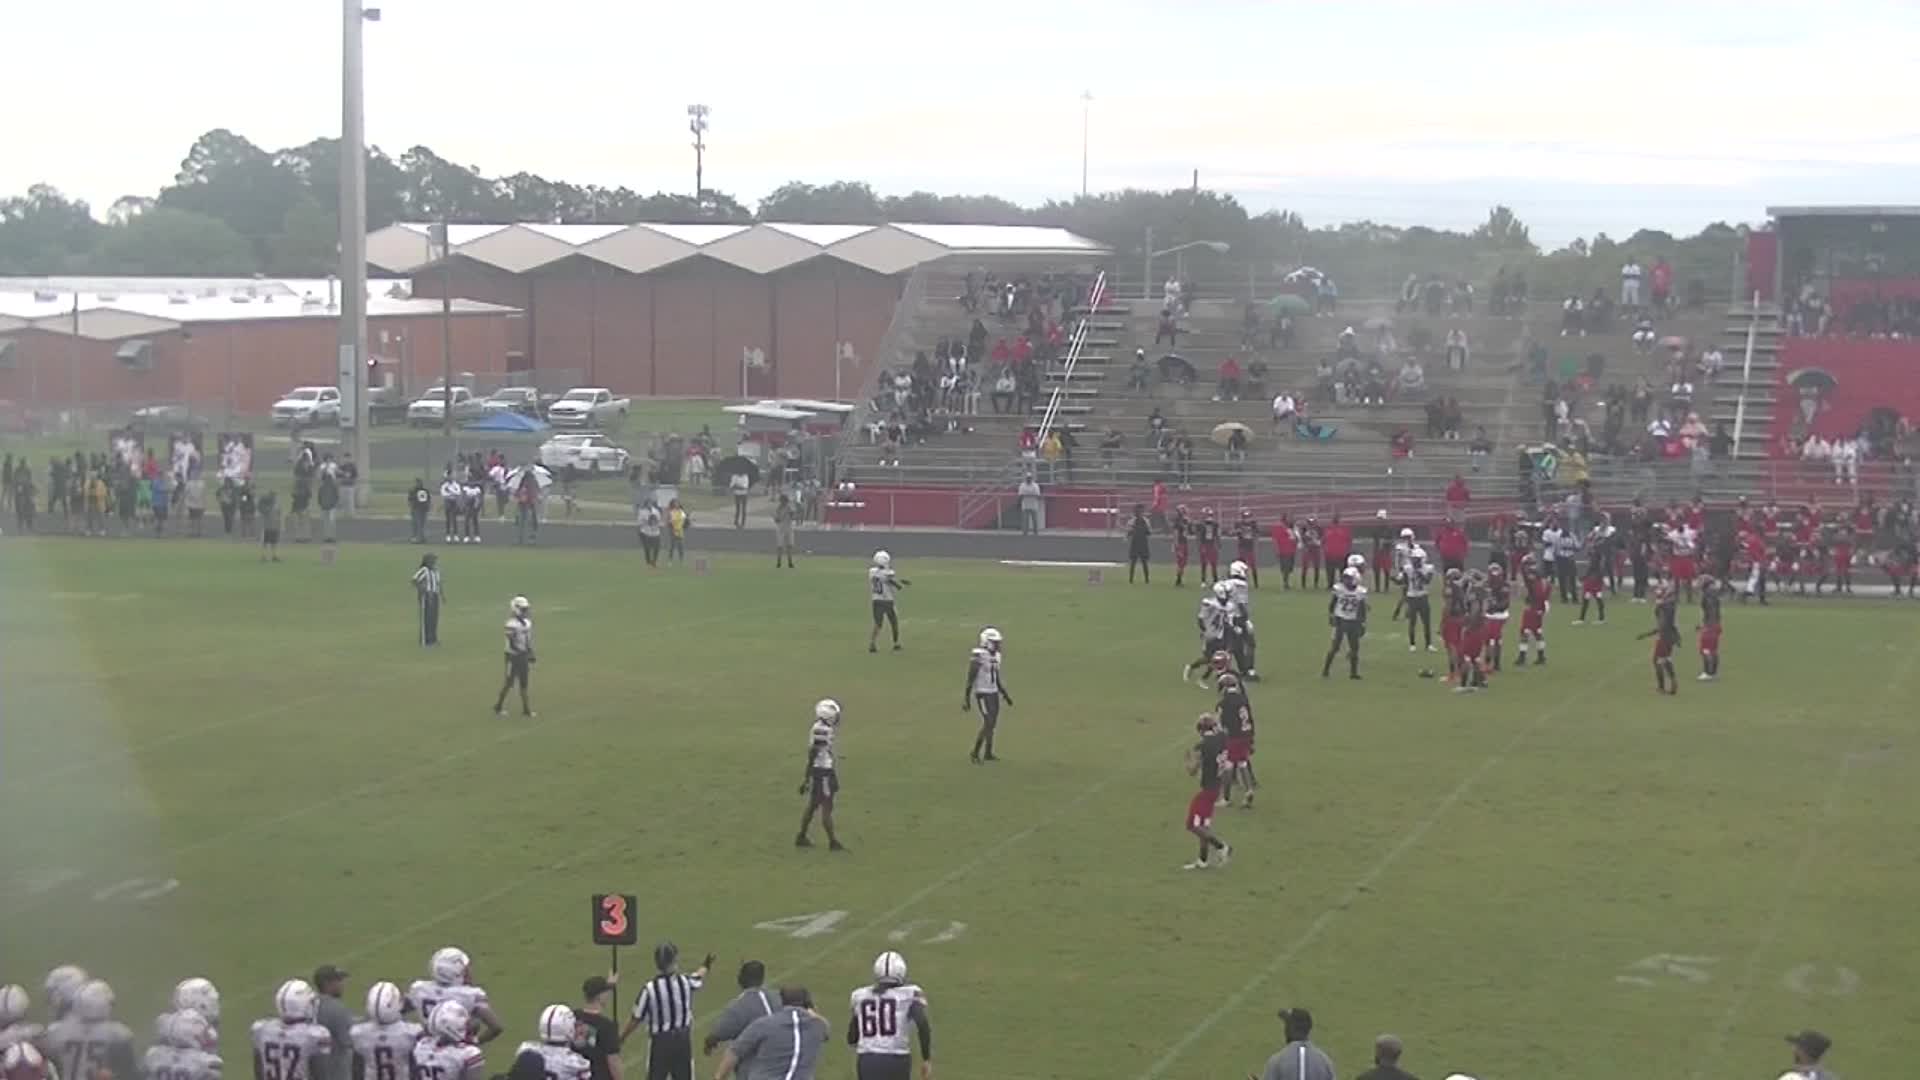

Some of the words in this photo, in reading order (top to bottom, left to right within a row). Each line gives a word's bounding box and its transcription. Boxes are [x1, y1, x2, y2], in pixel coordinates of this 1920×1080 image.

[601, 895, 628, 935] 3
[861, 998, 897, 1037] 60
[264, 1042, 301, 1080] 52
[375, 1046, 395, 1080] 6
